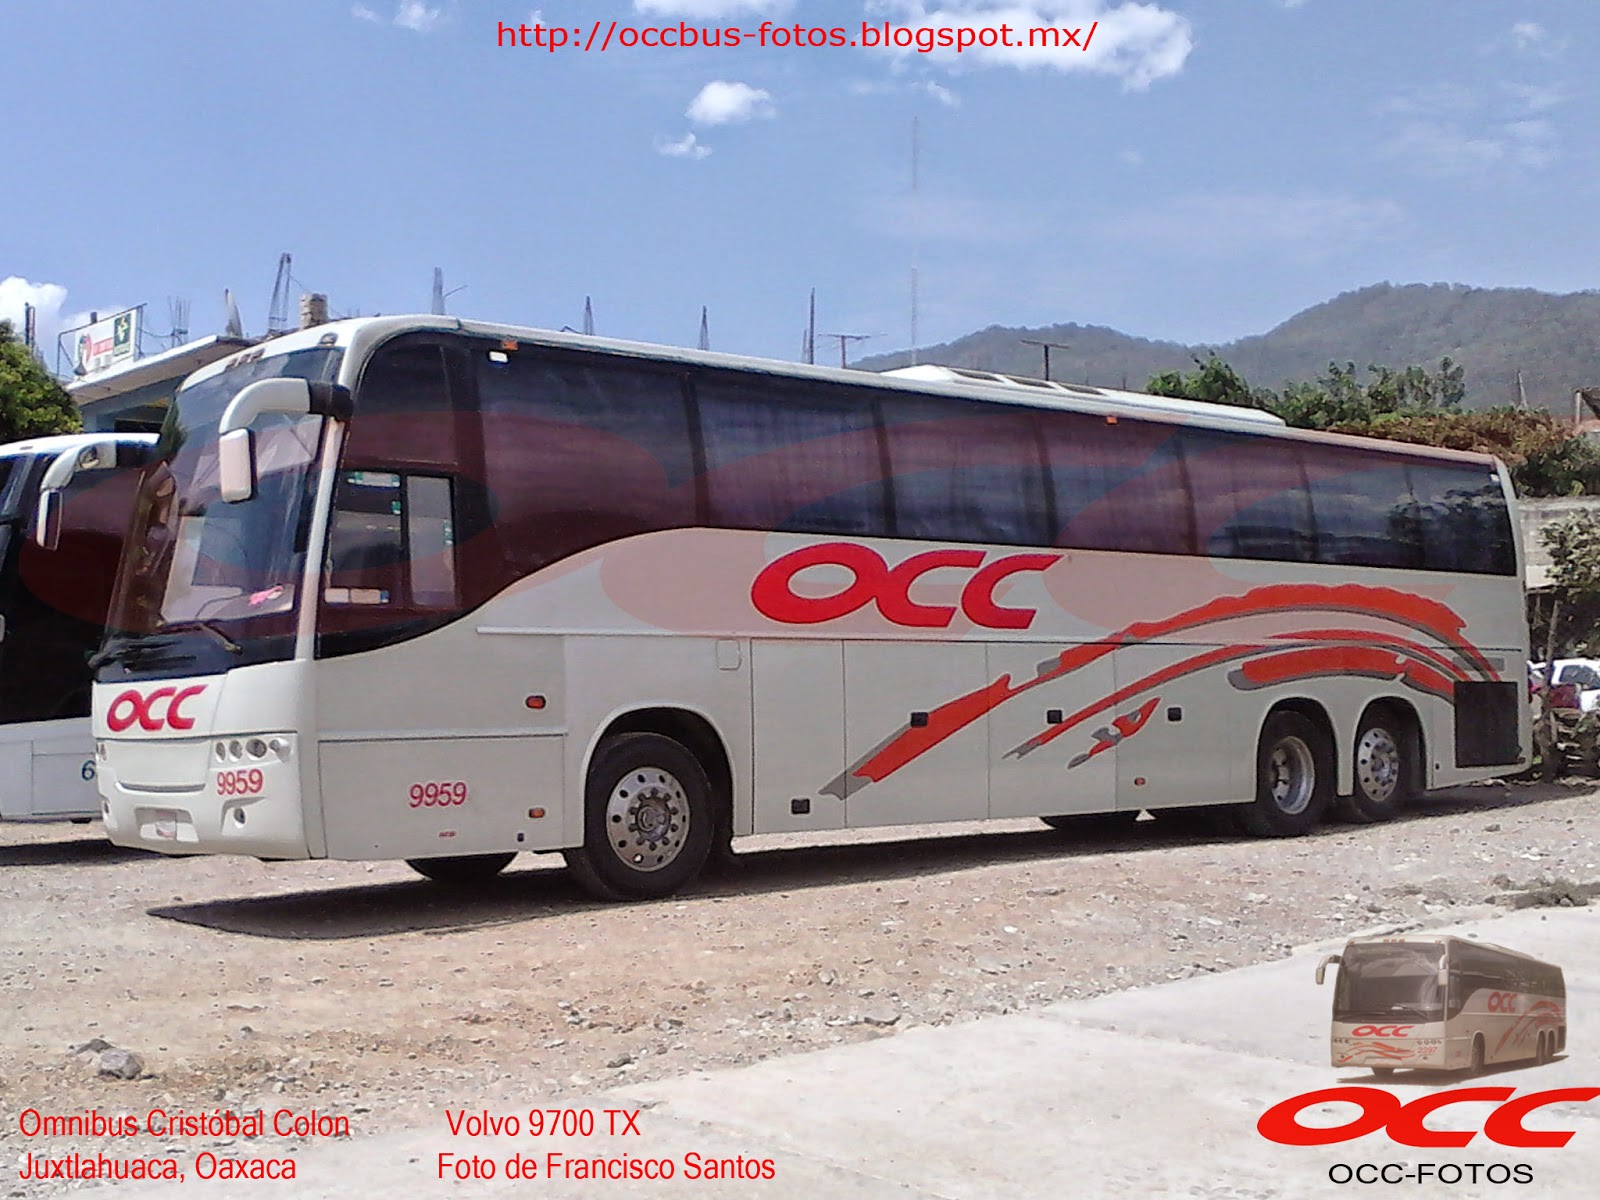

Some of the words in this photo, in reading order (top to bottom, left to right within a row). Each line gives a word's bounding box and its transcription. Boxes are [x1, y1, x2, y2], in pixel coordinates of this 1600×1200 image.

[752, 543, 1060, 629] OCC
[107, 685, 208, 732] OCC
[217, 769, 263, 795] 9959
[409, 783, 467, 808] 9959
